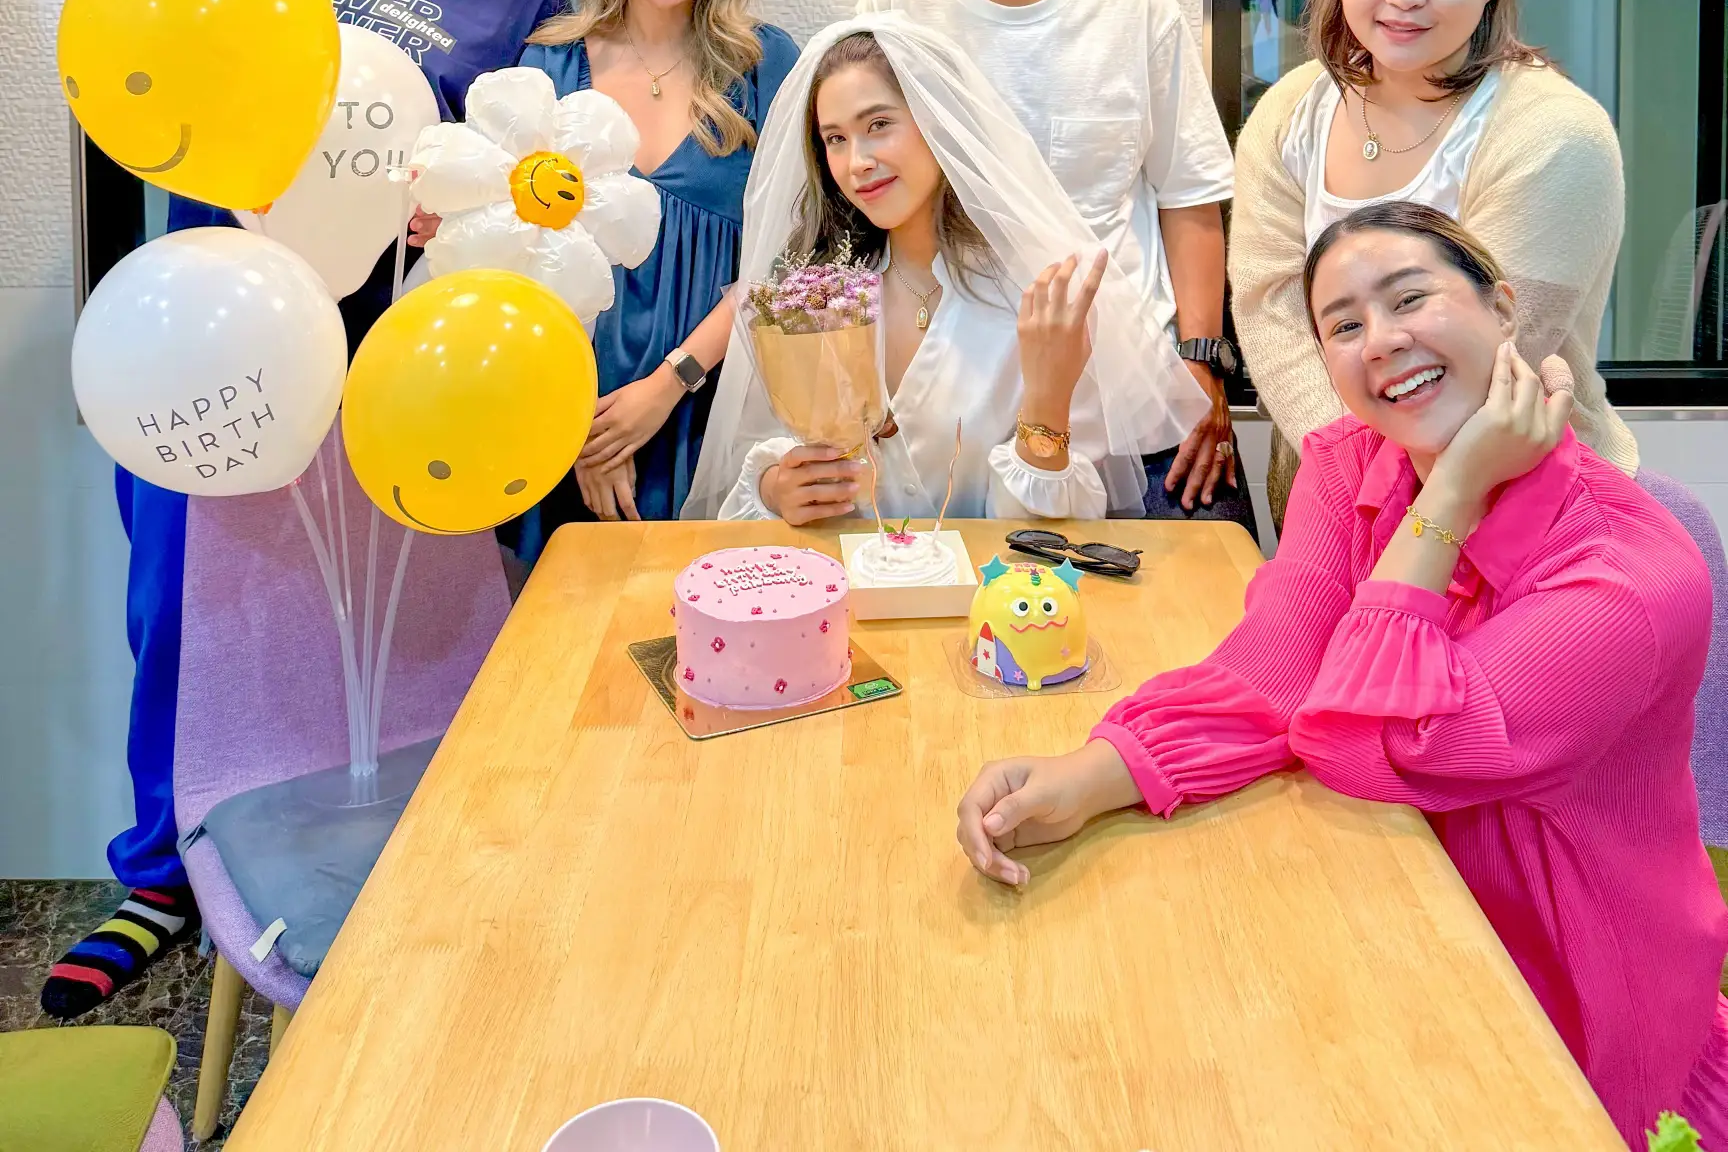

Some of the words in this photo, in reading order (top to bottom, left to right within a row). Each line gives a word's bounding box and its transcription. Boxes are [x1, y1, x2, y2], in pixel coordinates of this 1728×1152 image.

[379, 2, 454, 48] delighted
[337, 101, 394, 130] TO
[137, 368, 263, 437] HAPPY
[155, 403, 275, 463] BIRTH
[195, 441, 259, 479] DAY
